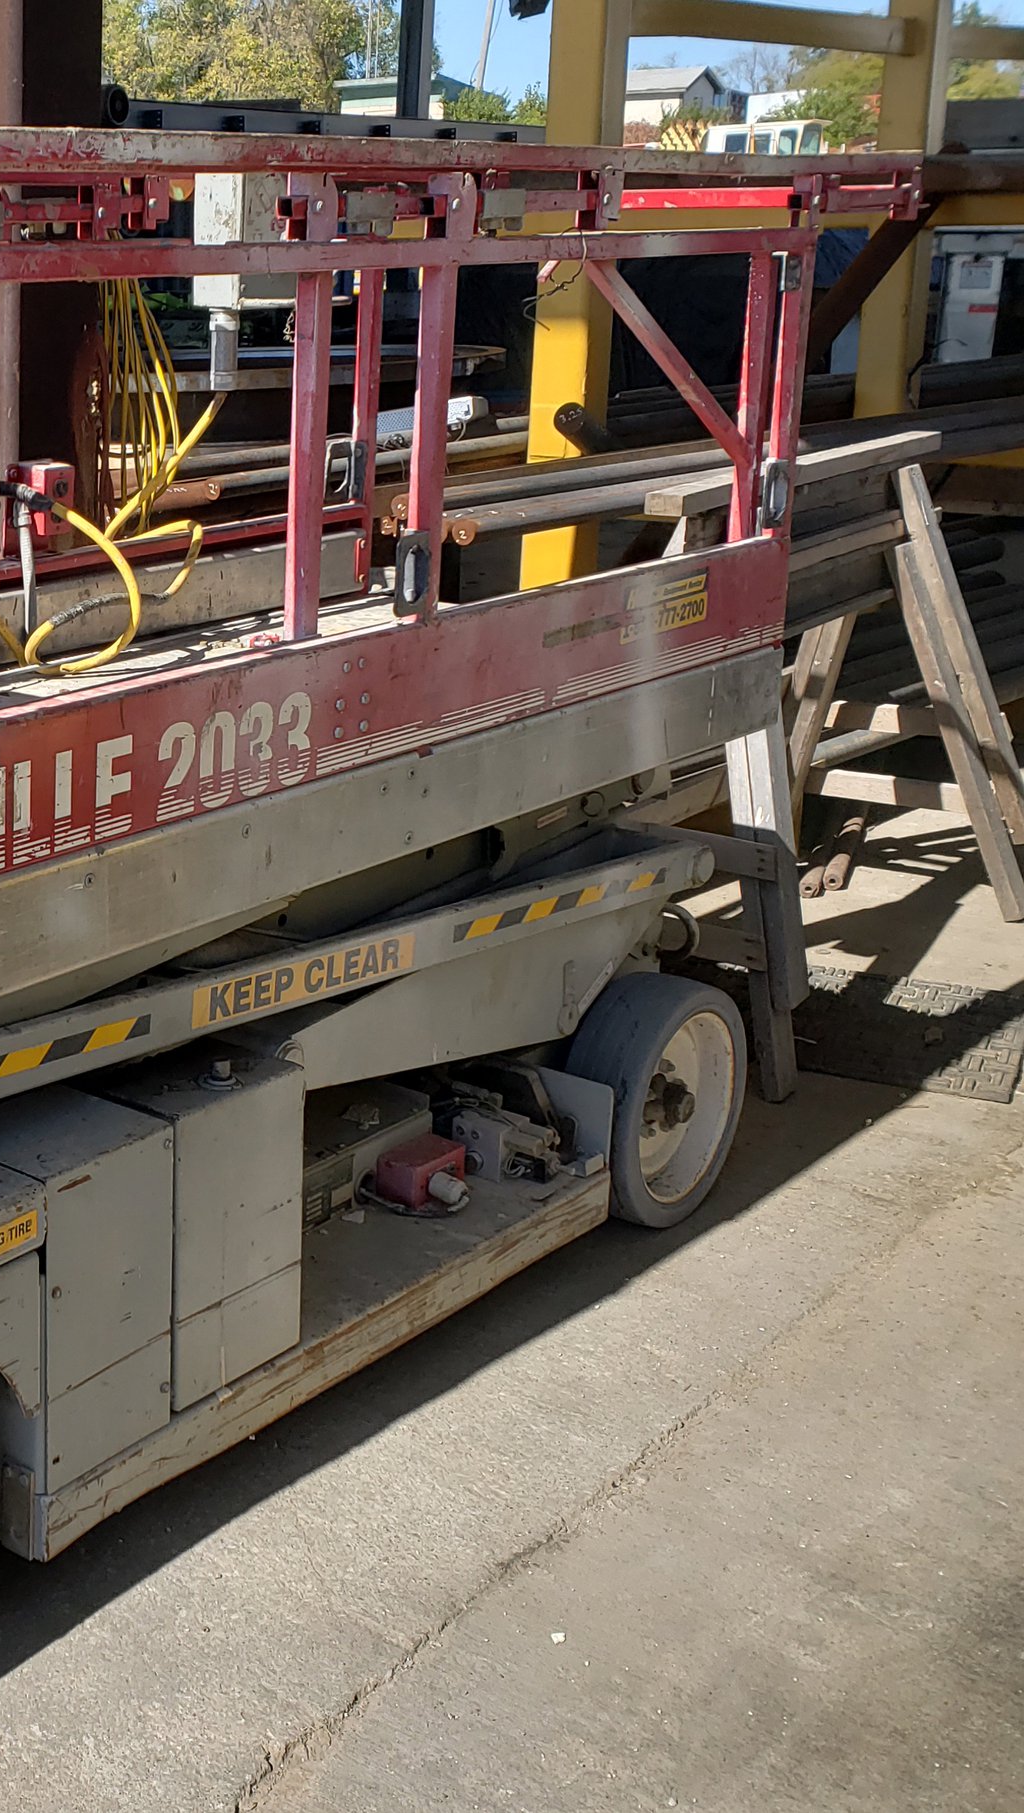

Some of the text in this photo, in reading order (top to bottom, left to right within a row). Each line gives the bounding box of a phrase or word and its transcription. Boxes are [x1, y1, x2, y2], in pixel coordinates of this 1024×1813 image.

[156, 692, 312, 822] 2033
[208, 938, 400, 1022] KEEP CLEAR
[7, 1218, 33, 1241] TIRE
